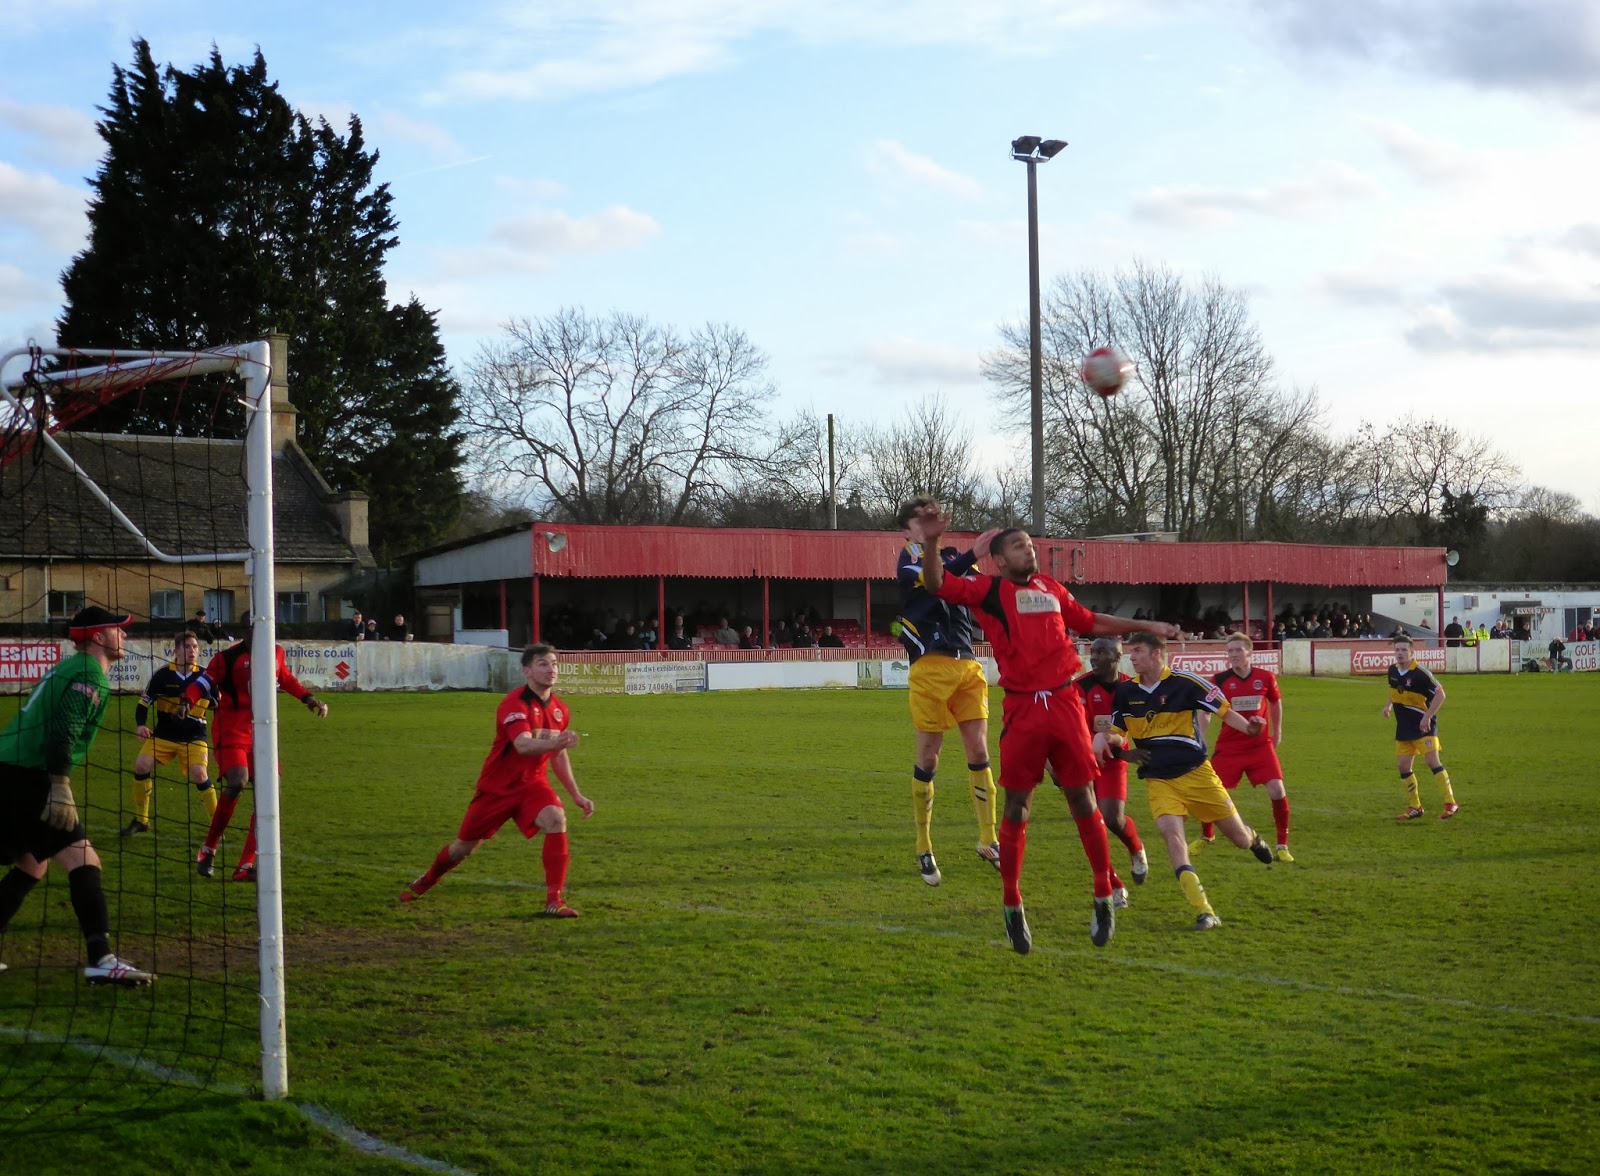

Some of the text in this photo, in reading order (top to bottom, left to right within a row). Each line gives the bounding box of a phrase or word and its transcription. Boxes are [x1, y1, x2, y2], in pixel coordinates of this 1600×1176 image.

[1575, 644, 1597, 656] GOLF
[296, 663, 328, 675] Dealer
[857, 661, 871, 678] UK
[1575, 657, 1597, 670] CLUB
[626, 683, 646, 691] 01825
